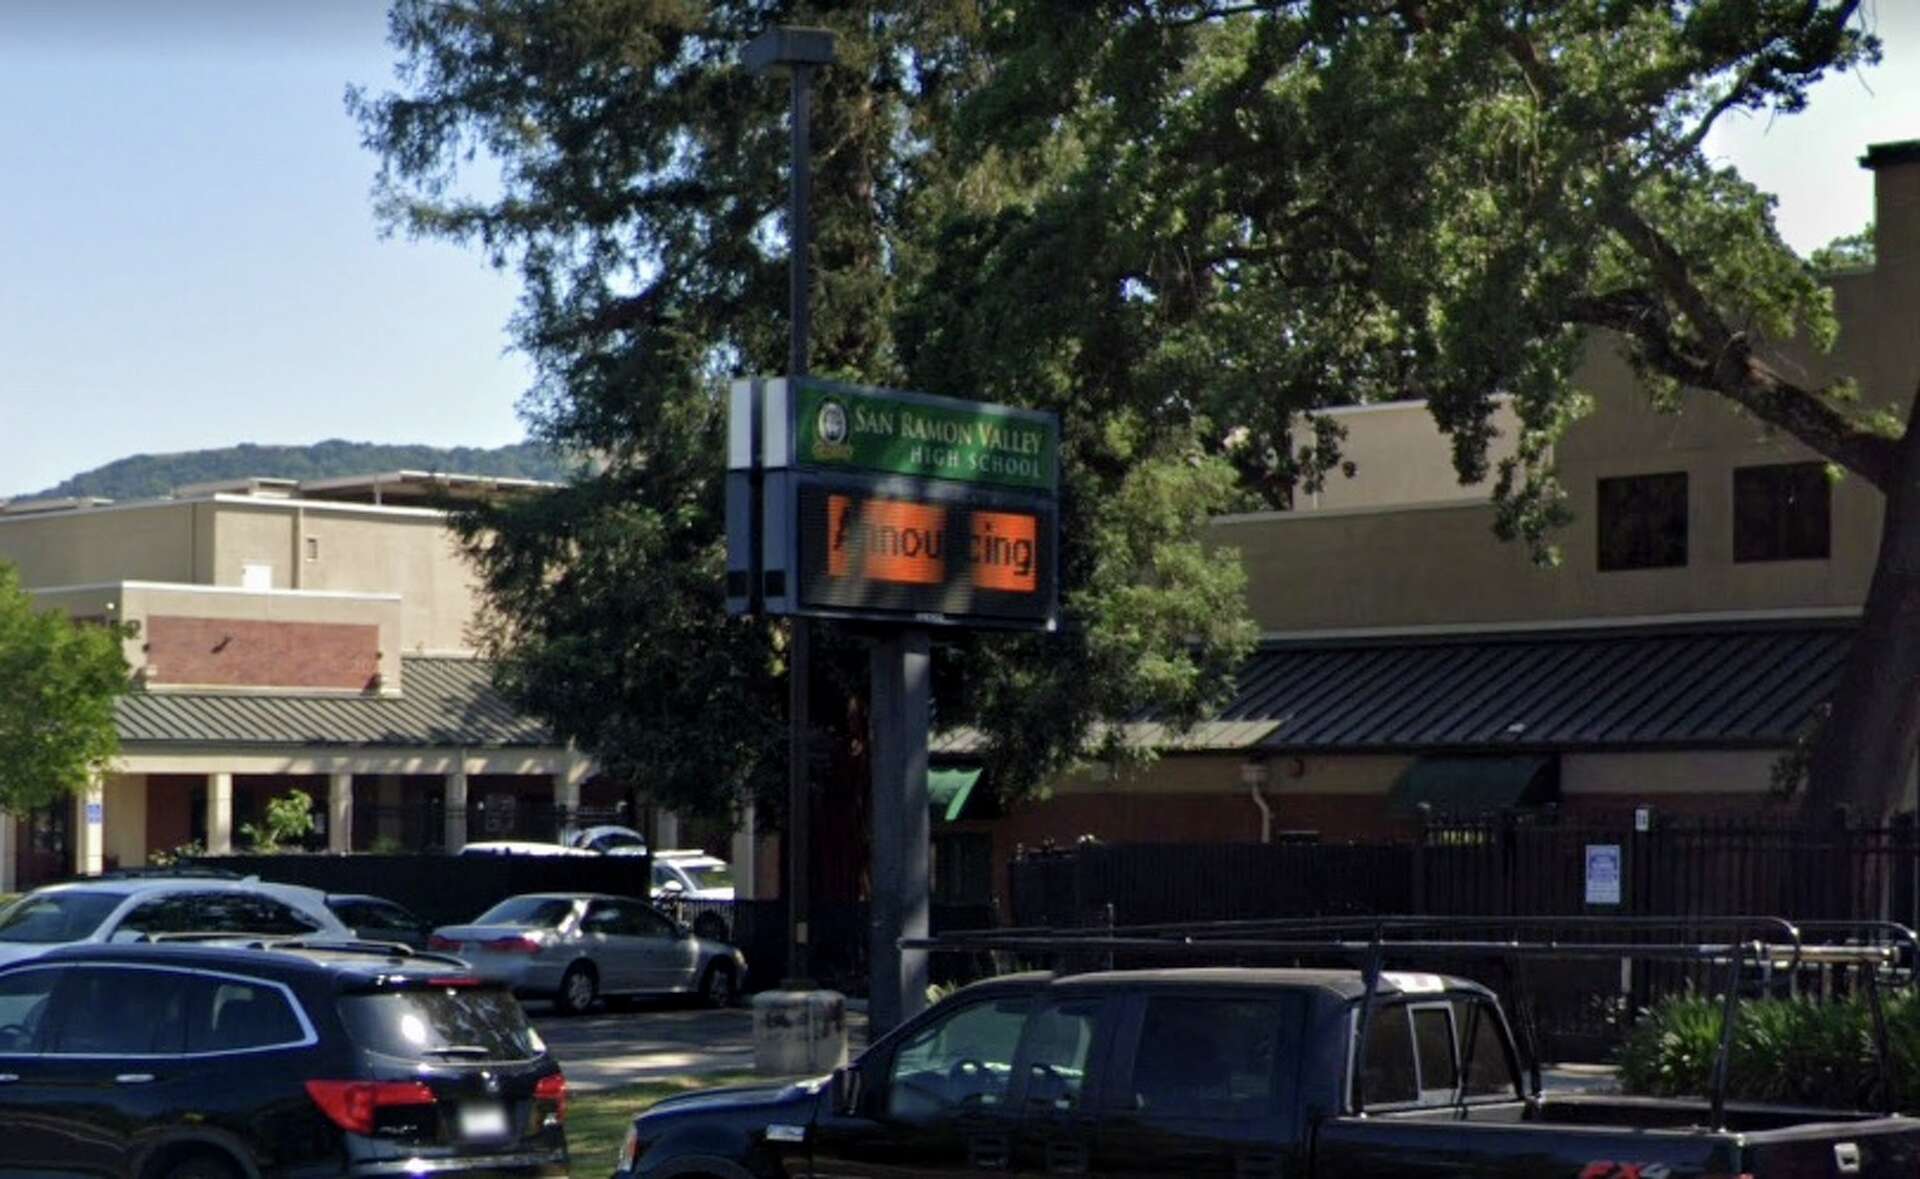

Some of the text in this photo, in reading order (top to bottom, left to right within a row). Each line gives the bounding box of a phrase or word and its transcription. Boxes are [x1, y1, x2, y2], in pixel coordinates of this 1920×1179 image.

[854, 404, 1042, 455] SAN RAMON VALLEY
[910, 445, 1041, 479] HIGH SCHOOL
